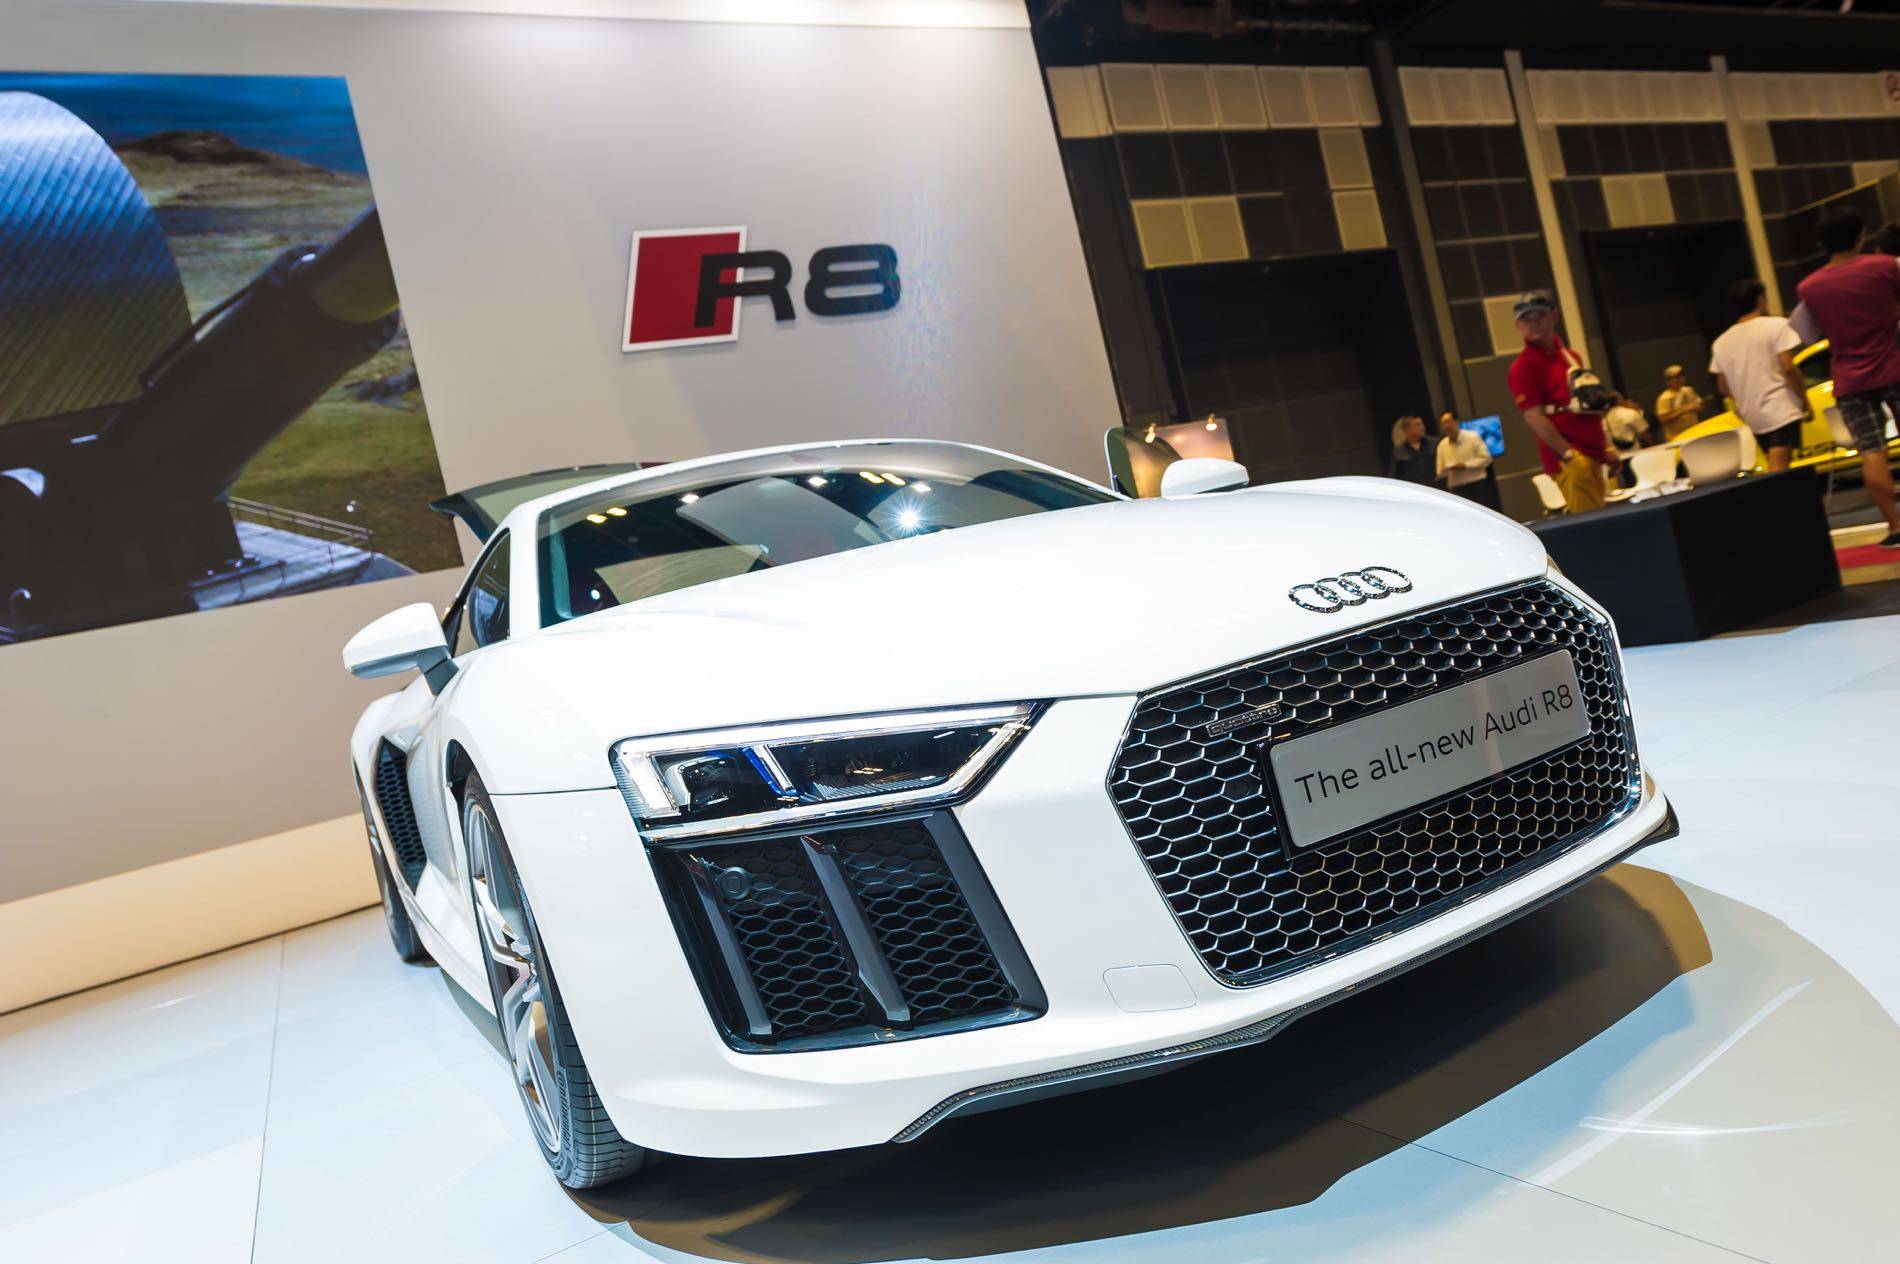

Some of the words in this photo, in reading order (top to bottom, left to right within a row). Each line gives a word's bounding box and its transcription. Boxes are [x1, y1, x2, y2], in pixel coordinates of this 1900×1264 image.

[694, 243, 901, 328] R8
[1294, 768, 1360, 803] The
[1368, 725, 1475, 781] all-new
[1484, 696, 1538, 740] Audi
[1542, 684, 1573, 716] R8
